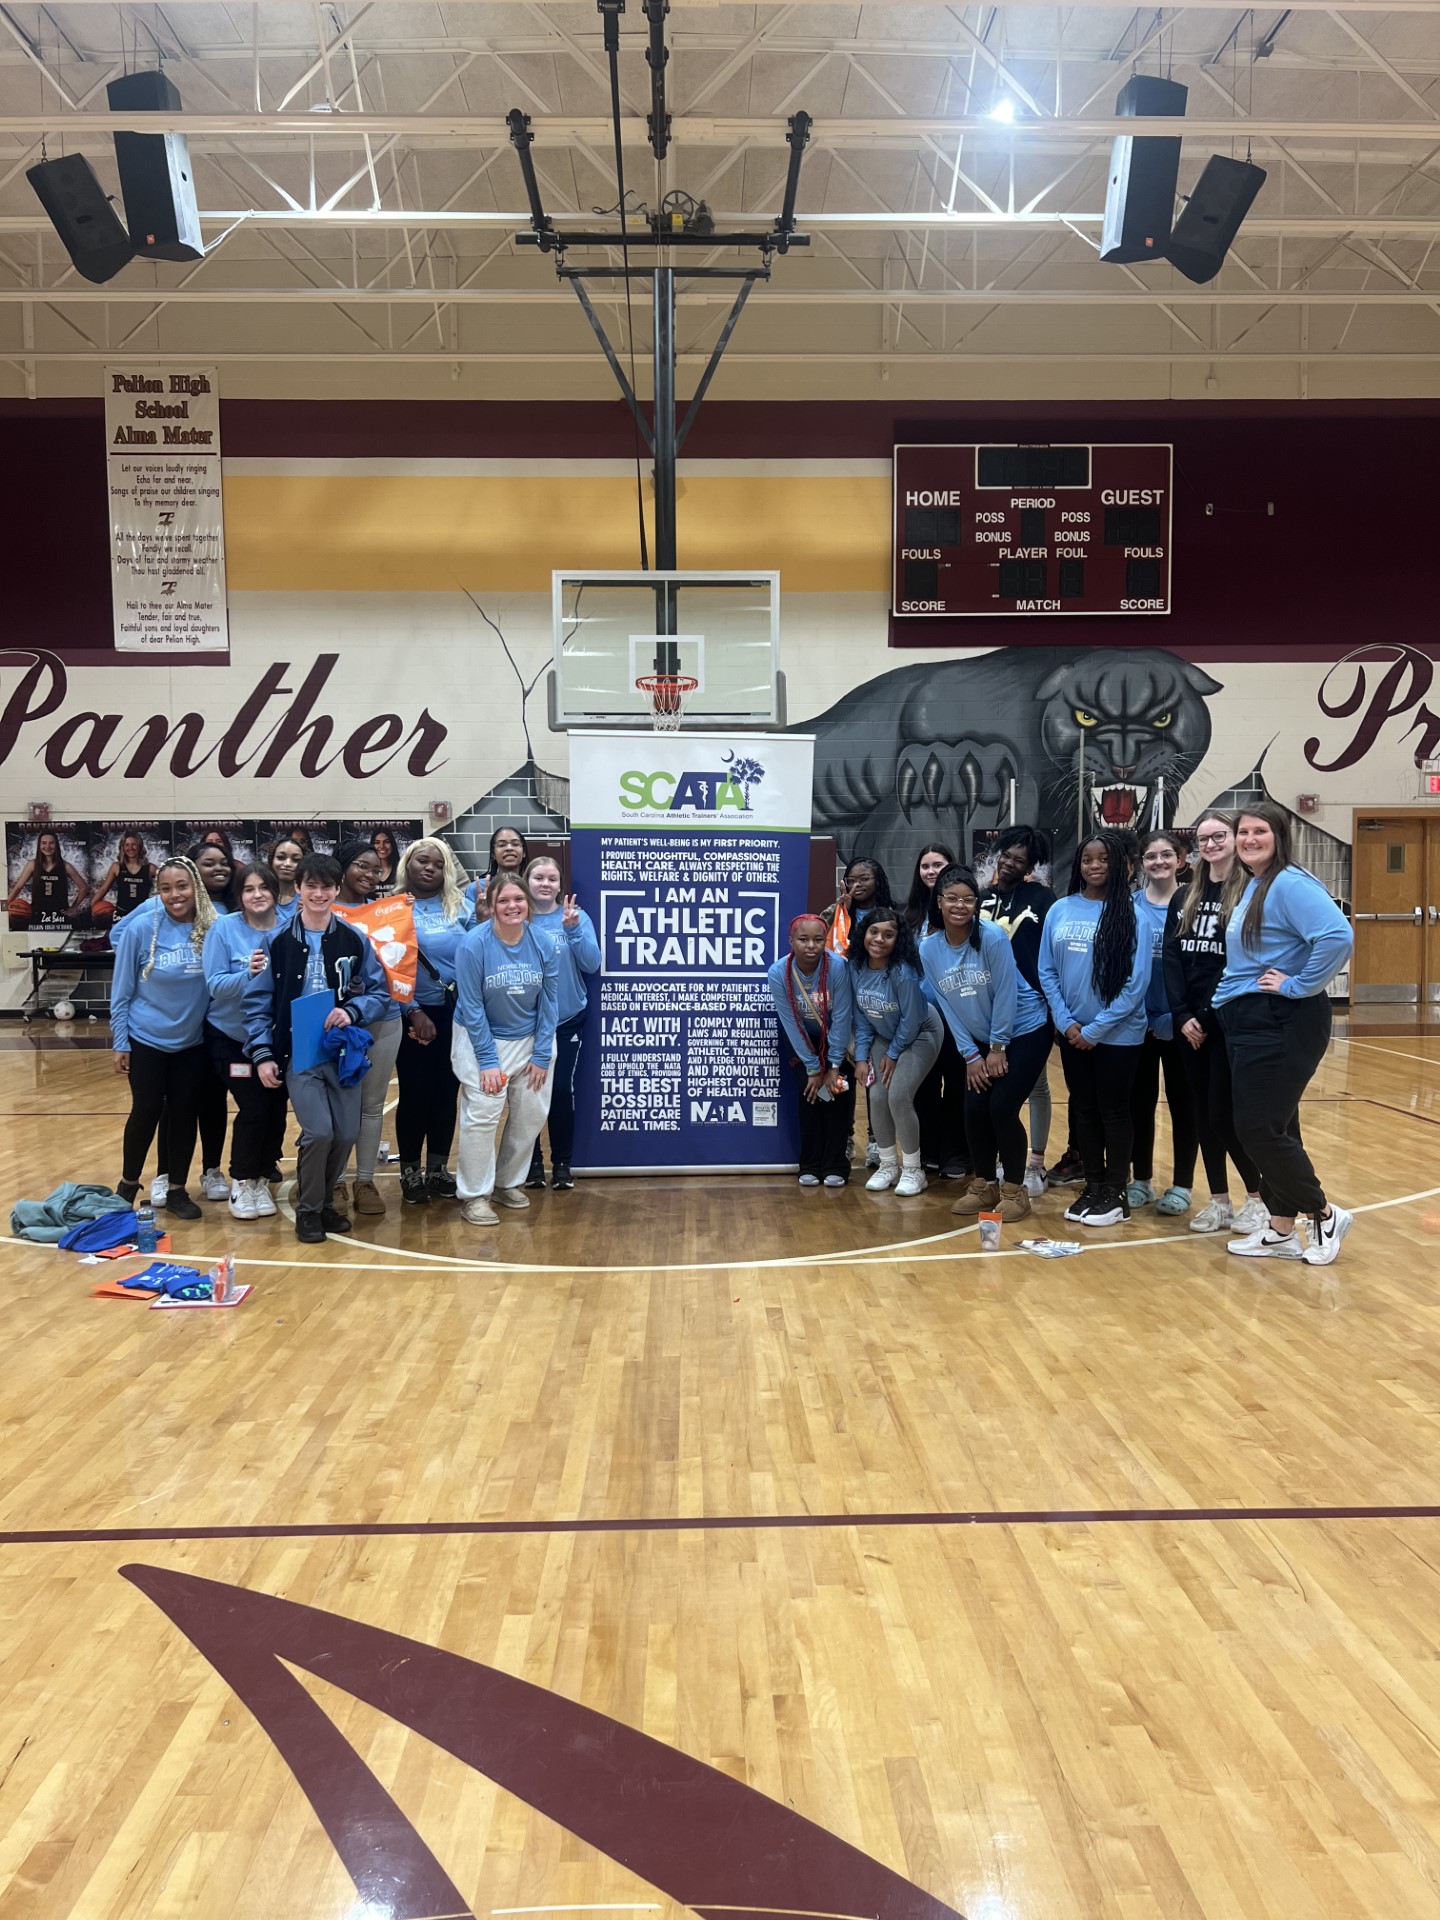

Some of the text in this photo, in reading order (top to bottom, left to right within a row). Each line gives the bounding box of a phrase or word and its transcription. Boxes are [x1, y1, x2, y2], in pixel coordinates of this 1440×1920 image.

[112, 374, 211, 396] Pelion High
[136, 400, 189, 418] School
[114, 426, 213, 444] Alma Mater
[122, 464, 130, 472] Let
[146, 464, 163, 472] voices
[166, 463, 184, 475] loudly
[186, 464, 206, 475] ringing
[136, 474, 193, 485] Echo far and near,
[111, 486, 128, 497] Songs
[131, 486, 137, 494] of
[140, 487, 158, 497] praise
[173, 486, 196, 494] children
[198, 487, 219, 497] singing
[1101, 489, 1163, 504] GUEST
[134, 497, 197, 508] To thy memory dear.
[906, 490, 960, 506] HOME
[1011, 498, 1055, 508] PERIOD
[976, 512, 1004, 522] POSS
[1061, 512, 1090, 522] POSS
[975, 531, 1011, 542] BONUS
[1054, 531, 1090, 541] BONUS
[902, 548, 940, 559] FOULS
[999, 547, 1087, 558] PLAYER FOUL
[1124, 547, 1163, 557] FOULS
[127, 601, 138, 609] Hail
[149, 601, 162, 609] thee
[177, 601, 192, 609] Alma
[902, 600, 945, 610] SCORE
[1016, 599, 1060, 609] MATCH
[1120, 599, 1163, 609] SCORE
[138, 612, 202, 621] Tender, fair and true,
[120, 624, 142, 632] Faithful
[160, 624, 171, 632] and
[174, 624, 188, 634] loyal
[191, 624, 220, 634] daughters
[141, 634, 200, 645] of dear Pelion High.
[0, 648, 450, 779] Panther
[618, 770, 746, 810] SCATA
[601, 837, 780, 849] MY PATIENT'S WELL-BEING IS MY FIRST PRIORITY.
[601, 851, 780, 863] I PROVIDE THOUGHTFUL, COMPASSIONATE
[602, 861, 780, 873] HEALTH CARE, ALWAYS RESPECTING THE
[601, 871, 778, 883] RIGHTS, WELFARE & DIGNITY OF OTHERS.
[655, 887, 728, 903] I AM AN
[615, 907, 765, 934] ATHLETIC
[615, 937, 764, 965] TRAINER
[1181, 939, 1225, 955] OOTBAL
[601, 983, 612, 993] AS
[614, 983, 628, 993] THE
[631, 984, 686, 993] ADVOCATE
[689, 984, 704, 993] FOR
[707, 984, 718, 993] MY
[722, 984, 759, 993] PATIENT'S
[601, 1002, 626, 1011] BASED
[629, 1002, 640, 1011] ON
[642, 1002, 726, 1011] EVIDENCE-BASED
[602, 1017, 680, 1033] I ACT WITH
[688, 1017, 776, 1028] I COMPLY WITH THE
[687, 1029, 777, 1038] LAWS AND REGULATIONS
[601, 1034, 680, 1047] INTEGRITY.
[601, 1053, 681, 1063] I FULLY UNDERSTAND
[687, 1048, 779, 1058] ATHLETIC TRAINING,
[688, 1065, 779, 1077] AND PROMOTE THE
[600, 1079, 681, 1093] THE BEST
[688, 1078, 780, 1087] HIGHEST QUALITY
[687, 1088, 780, 1097] OF HEALTH CARE.
[601, 1094, 680, 1108] POSSIBLE
[601, 1109, 680, 1119] PATIENT CARE
[600, 1121, 615, 1131] AT
[618, 1121, 639, 1131] ALL
[642, 1121, 680, 1131] TIMES.
